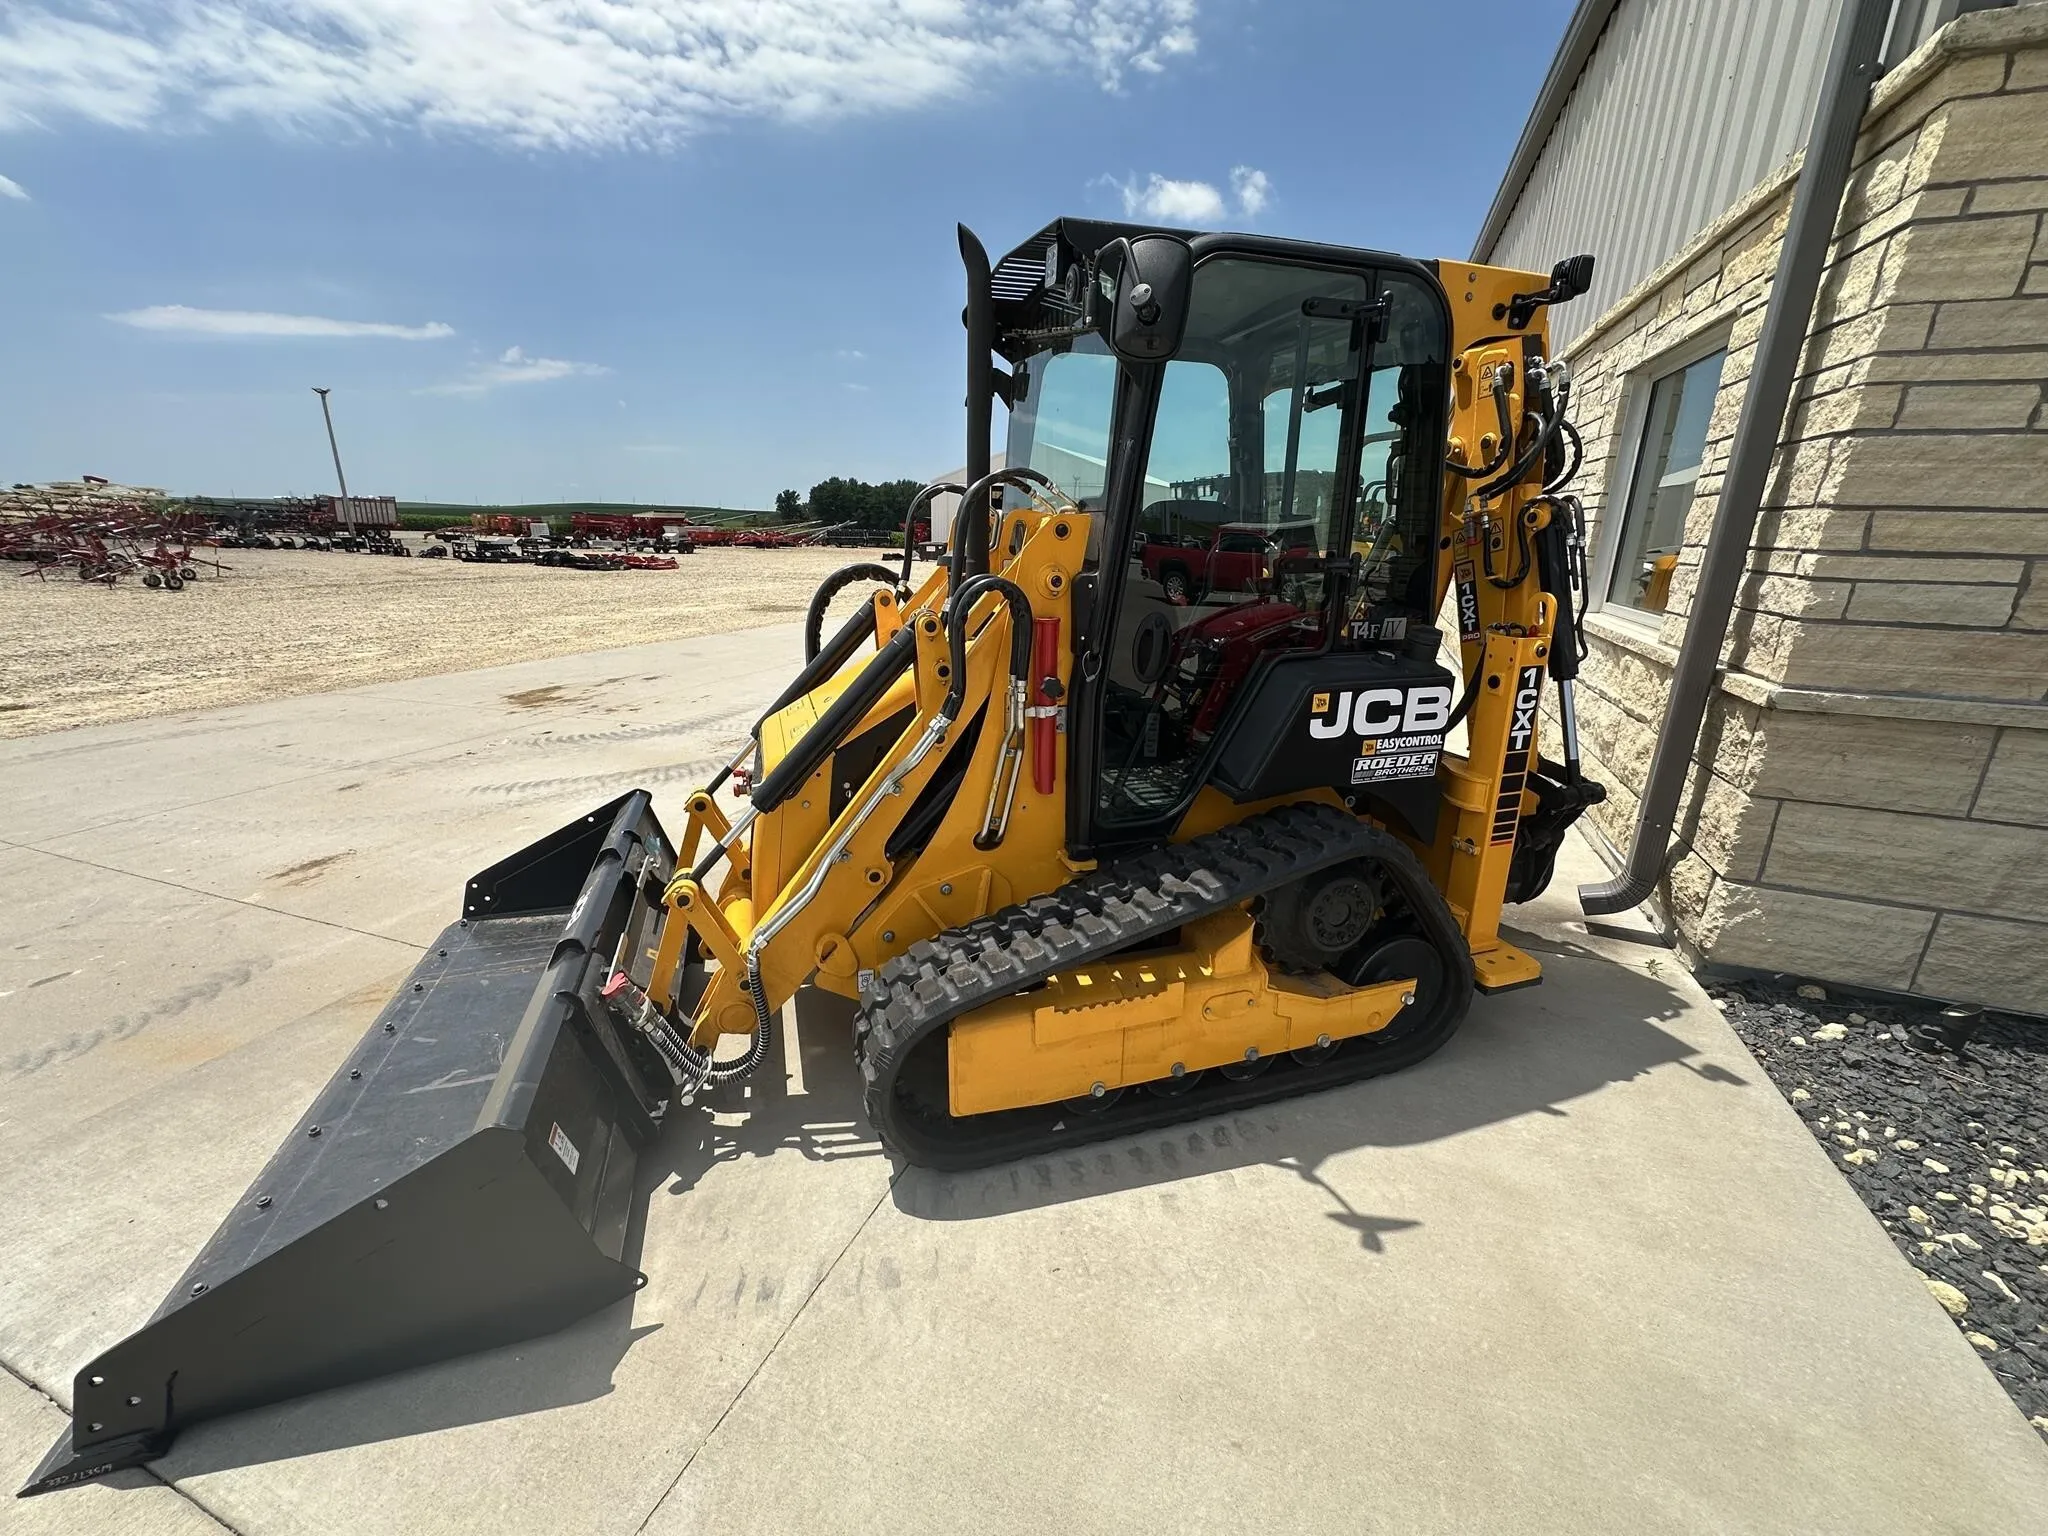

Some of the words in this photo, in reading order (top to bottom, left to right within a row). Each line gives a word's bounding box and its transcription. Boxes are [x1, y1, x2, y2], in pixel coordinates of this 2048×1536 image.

[1461, 583, 1476, 631] 1CXT
[1462, 632, 1480, 641] PRO
[1309, 686, 1451, 739] JCB
[1511, 667, 1538, 750] 1CXT
[1355, 753, 1436, 771] ROEDER
[1374, 765, 1430, 777] BROTHERS
